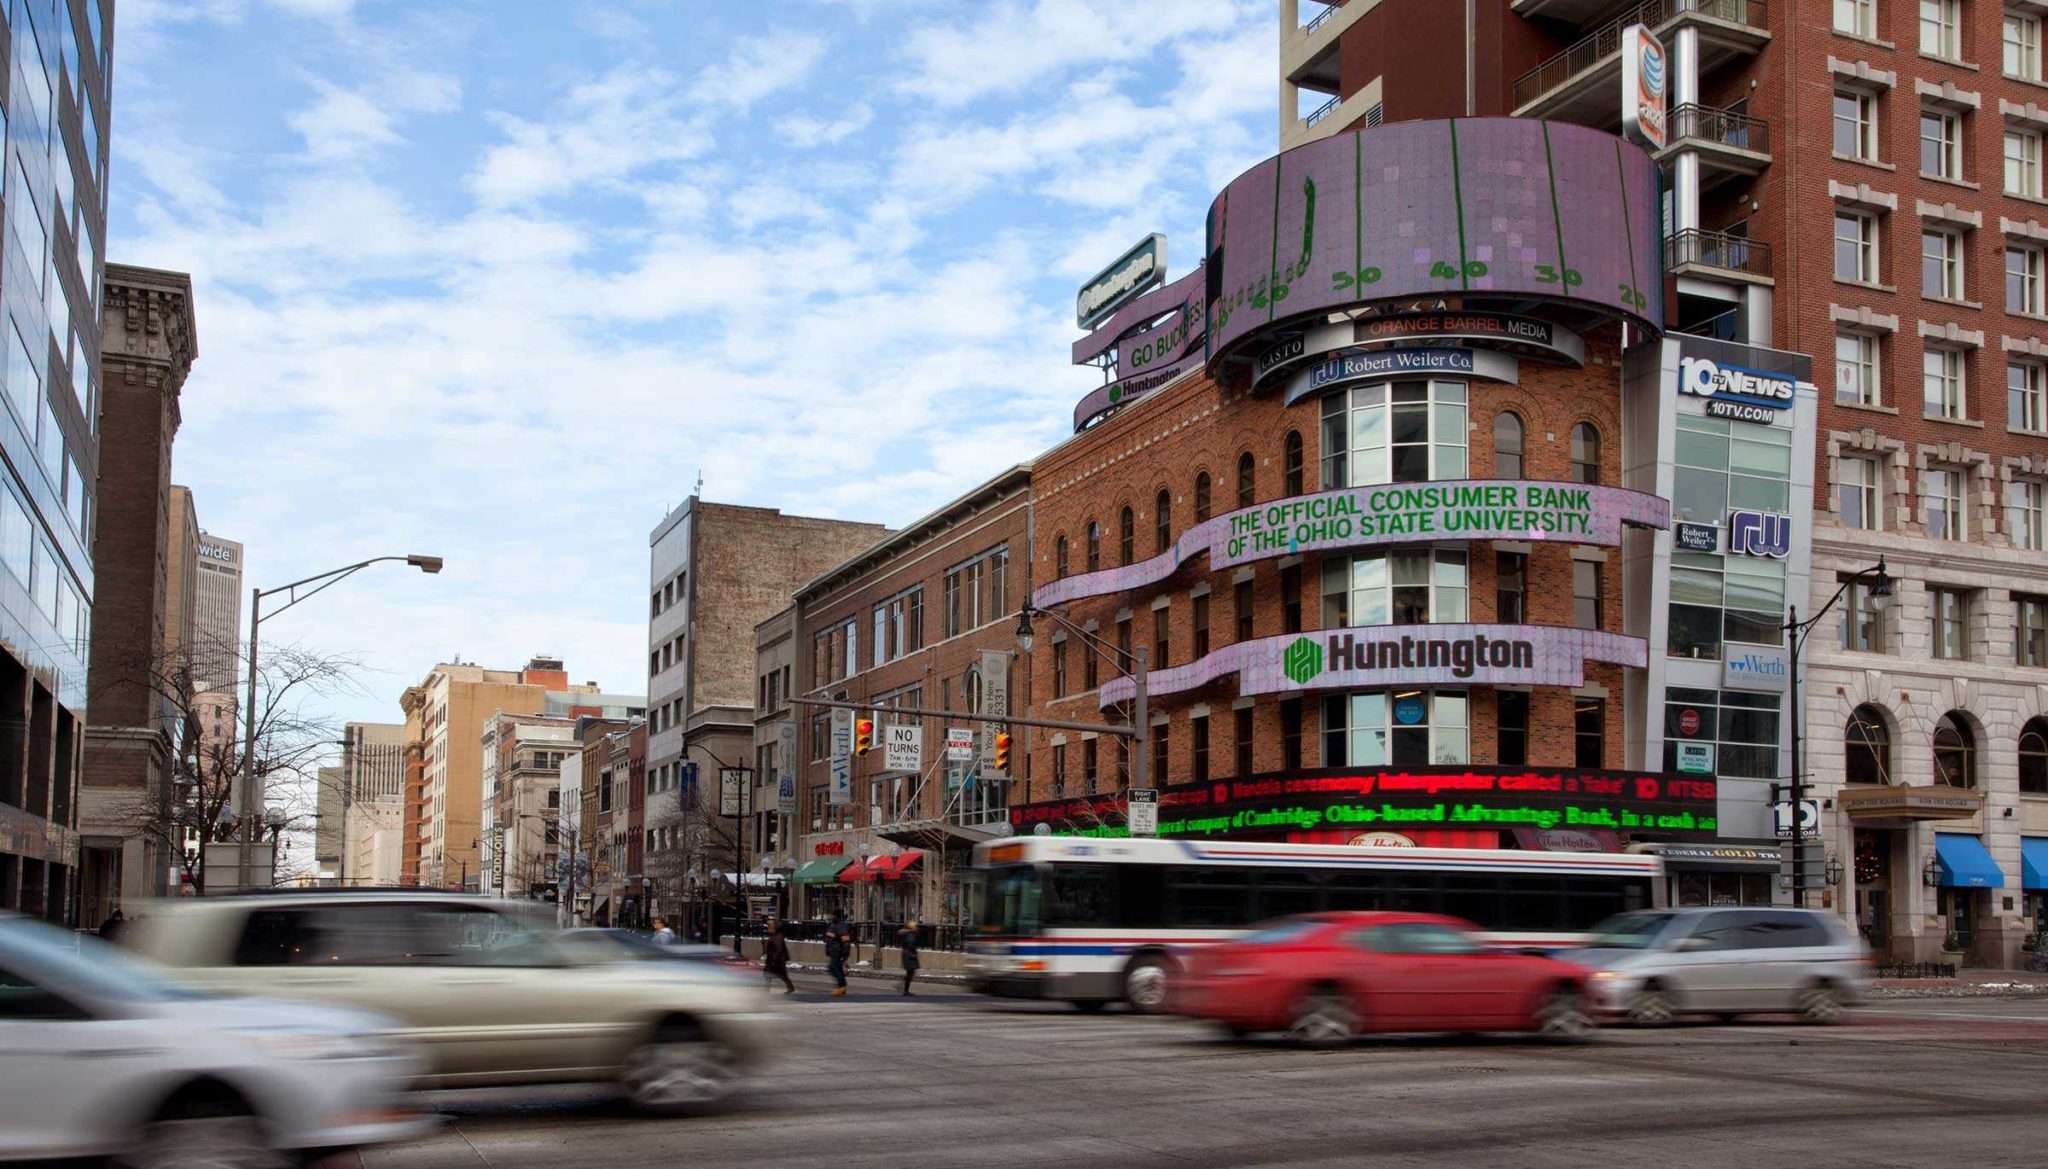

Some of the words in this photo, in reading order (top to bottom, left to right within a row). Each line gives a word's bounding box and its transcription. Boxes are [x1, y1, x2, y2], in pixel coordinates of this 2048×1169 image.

[1332, 267, 1382, 291] 50
[1430, 260, 1488, 279] 40
[1534, 264, 1583, 287] 30
[1618, 284, 1647, 310] 20
[1131, 343, 1153, 368] GO
[1156, 299, 1204, 358] BUCKES!
[1370, 317, 1438, 336] ORANGE
[1444, 317, 1504, 334] BARREL
[1508, 319, 1547, 340] MEDIA
[1261, 340, 1302, 369] CASTO
[1344, 357, 1392, 375] Robert
[1396, 352, 1446, 369] Weiler
[1449, 352, 1472, 369] Co.
[1681, 357, 1719, 397] 10
[1720, 369, 1793, 400] NEWS
[1711, 401, 1775, 423] 10TV.COM
[1229, 509, 1262, 536] THE
[1266, 496, 1362, 528] OFFICIAL
[1370, 486, 1518, 513] CONSUMER
[1526, 487, 1592, 512] BANK
[1227, 538, 1251, 559] OF
[1254, 528, 1289, 553] THE
[1295, 520, 1352, 545] OHIO
[1360, 512, 1436, 537] STATE
[1444, 508, 1594, 536] UNIVERSITY.
[1682, 527, 1709, 539] Robert
[1682, 534, 1706, 546] Weiler
[1329, 633, 1533, 678] Huntington
[1744, 655, 1785, 676] Werth
[985, 680, 994, 701] Here
[895, 729, 912, 742] NO
[985, 728, 994, 751] Your
[833, 728, 849, 773] Werth
[888, 743, 919, 754] TURNS
[1284, 774, 1376, 796] ceremony
[1378, 772, 1497, 795] interpreter
[1498, 772, 1561, 791] called
[1565, 777, 1578, 792] a
[1667, 779, 1717, 799] NTSB
[1187, 816, 1231, 835] company
[1232, 811, 1244, 828] of
[1325, 804, 1446, 823] Ohio-based
[1450, 804, 1563, 829] Advantage
[1565, 806, 1620, 829] Bank,
[1621, 809, 1640, 827] in
[1643, 814, 1655, 827] a
[1657, 811, 1695, 829] cash
[1774, 801, 1817, 831] 10
[1541, 835, 1563, 847] Tim
[1714, 849, 1757, 859] GOLD
